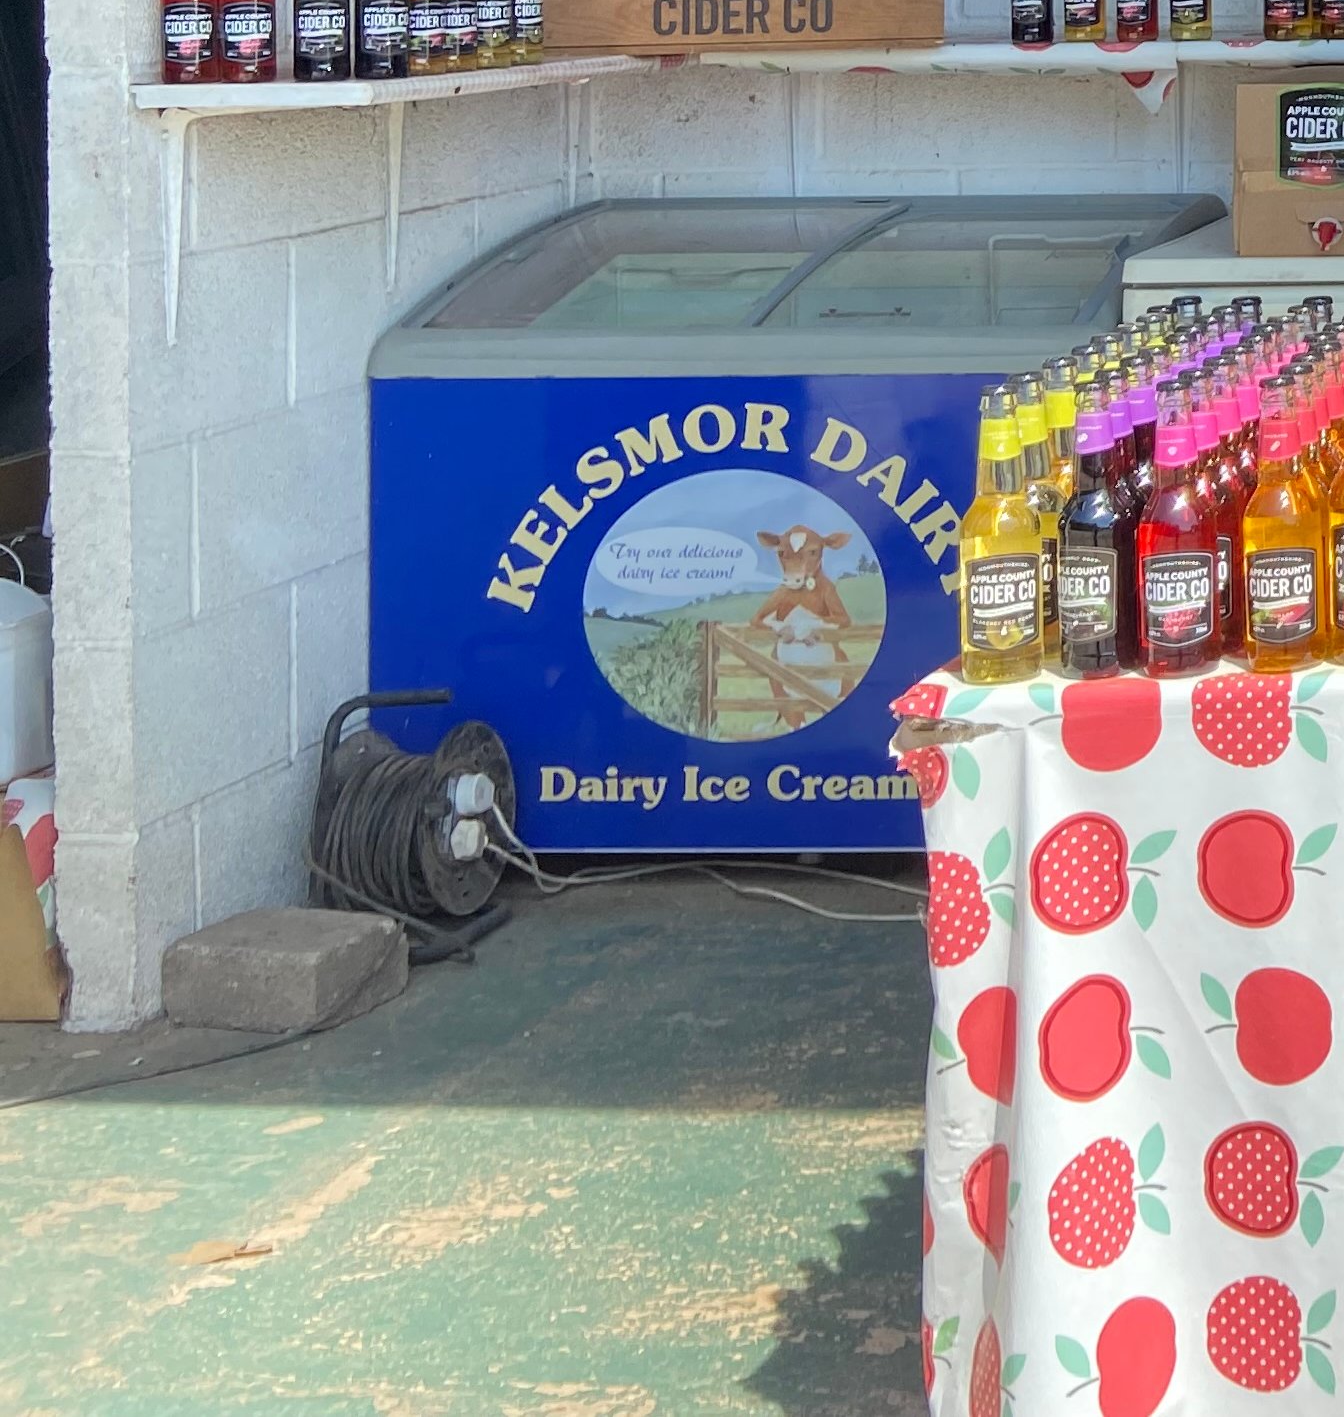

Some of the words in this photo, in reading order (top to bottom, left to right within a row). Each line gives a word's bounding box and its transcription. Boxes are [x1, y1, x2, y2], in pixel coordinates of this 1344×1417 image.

[1287, 106, 1320, 116] APPLE
[1286, 117, 1338, 139] CIDER
[486, 402, 790, 614] KELSMOR
[609, 542, 640, 563] Try
[647, 548, 672, 558] our
[679, 543, 743, 558] delicious
[617, 565, 654, 584] dairy
[660, 567, 680, 579] ice
[999, 568, 1036, 582] COUNTY
[970, 584, 1019, 605] CIDER
[1021, 580, 1036, 599] CO
[1145, 582, 1188, 602] CIDER
[1190, 579, 1209, 598] CO
[1250, 578, 1292, 598] CIDER
[1293, 574, 1313, 594] CO
[539, 765, 668, 810] Dairy
[683, 765, 750, 802] Ice
[766, 765, 920, 802] Cream
